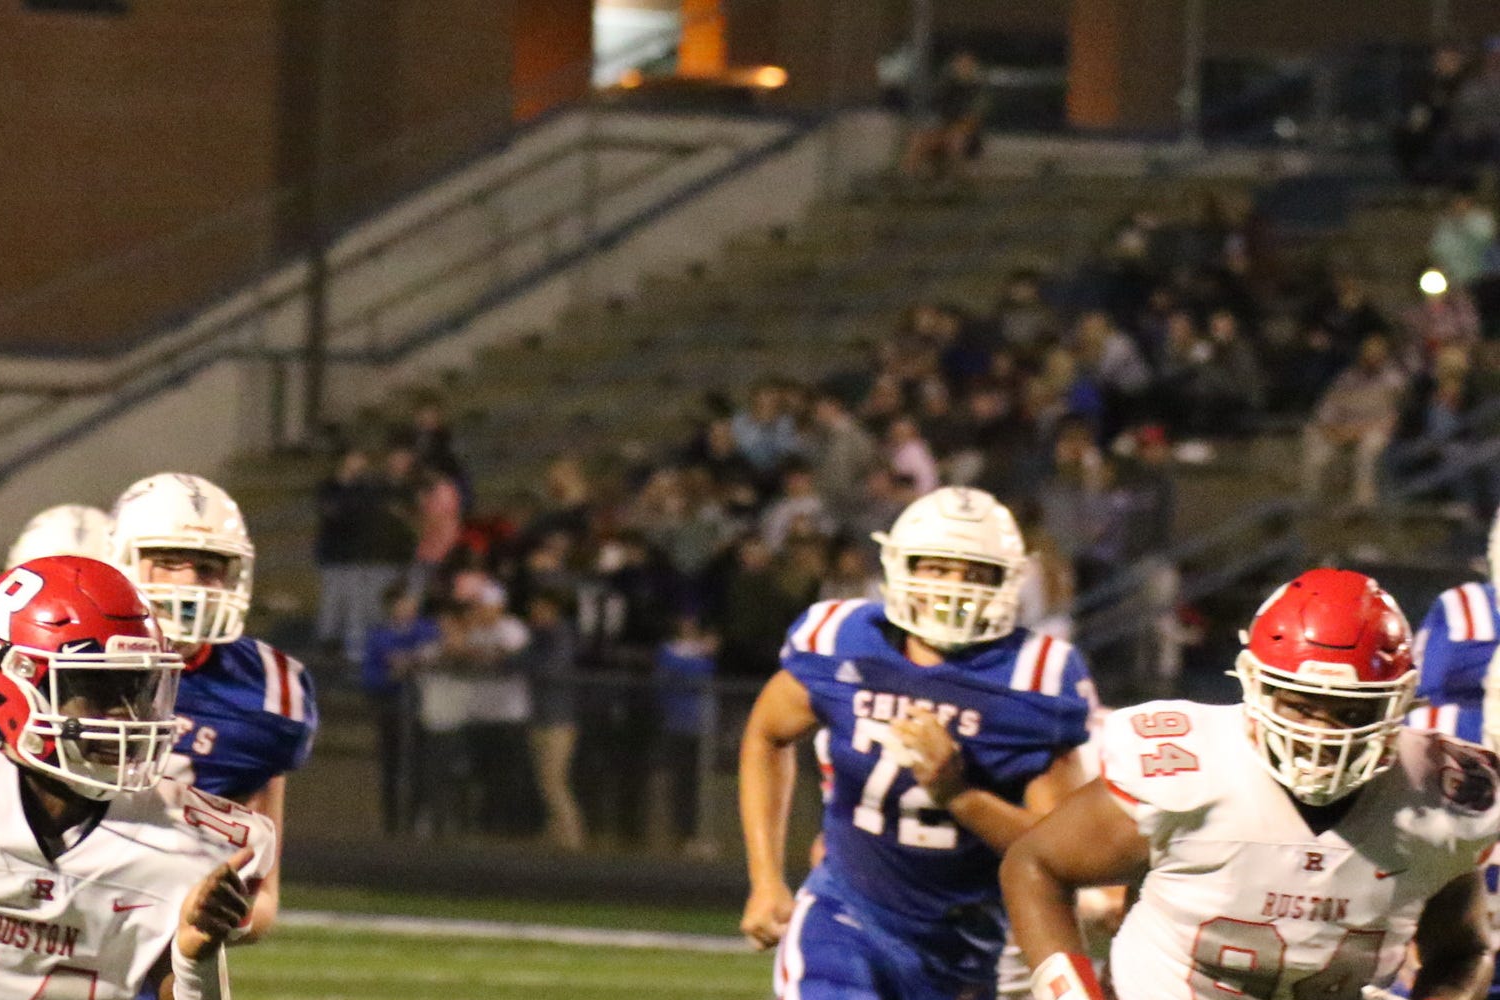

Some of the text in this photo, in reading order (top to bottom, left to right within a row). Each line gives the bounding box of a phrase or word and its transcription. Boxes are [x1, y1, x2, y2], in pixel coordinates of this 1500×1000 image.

[853, 690, 981, 736] CHIFS
[1131, 711, 1200, 777] 94
[1304, 852, 1325, 871] R
[32, 879, 55, 900] R
[1261, 892, 1350, 921] RUSTON
